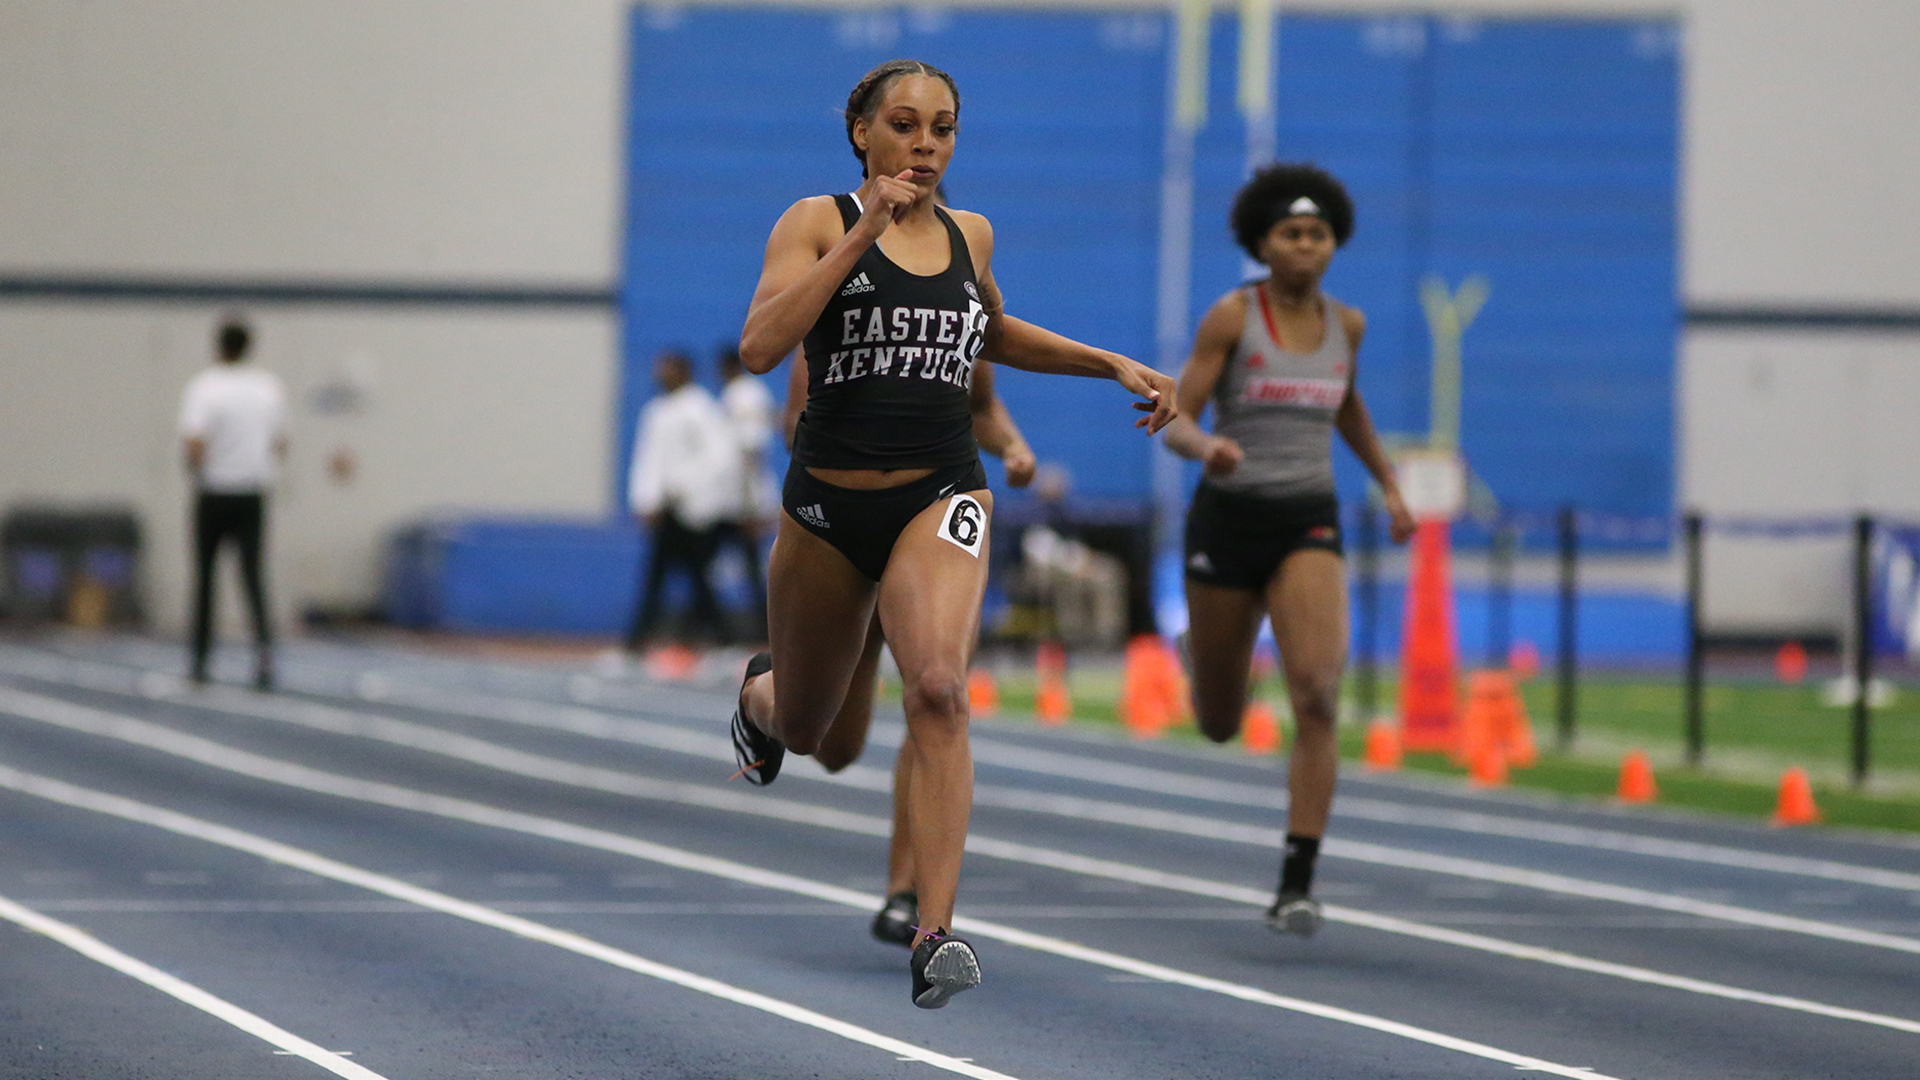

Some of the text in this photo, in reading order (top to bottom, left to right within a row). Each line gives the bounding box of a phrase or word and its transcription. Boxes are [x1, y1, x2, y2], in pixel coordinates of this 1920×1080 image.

[841, 283, 875, 296] adidas
[796, 507, 831, 529] adidas
[948, 499, 981, 547] 6
